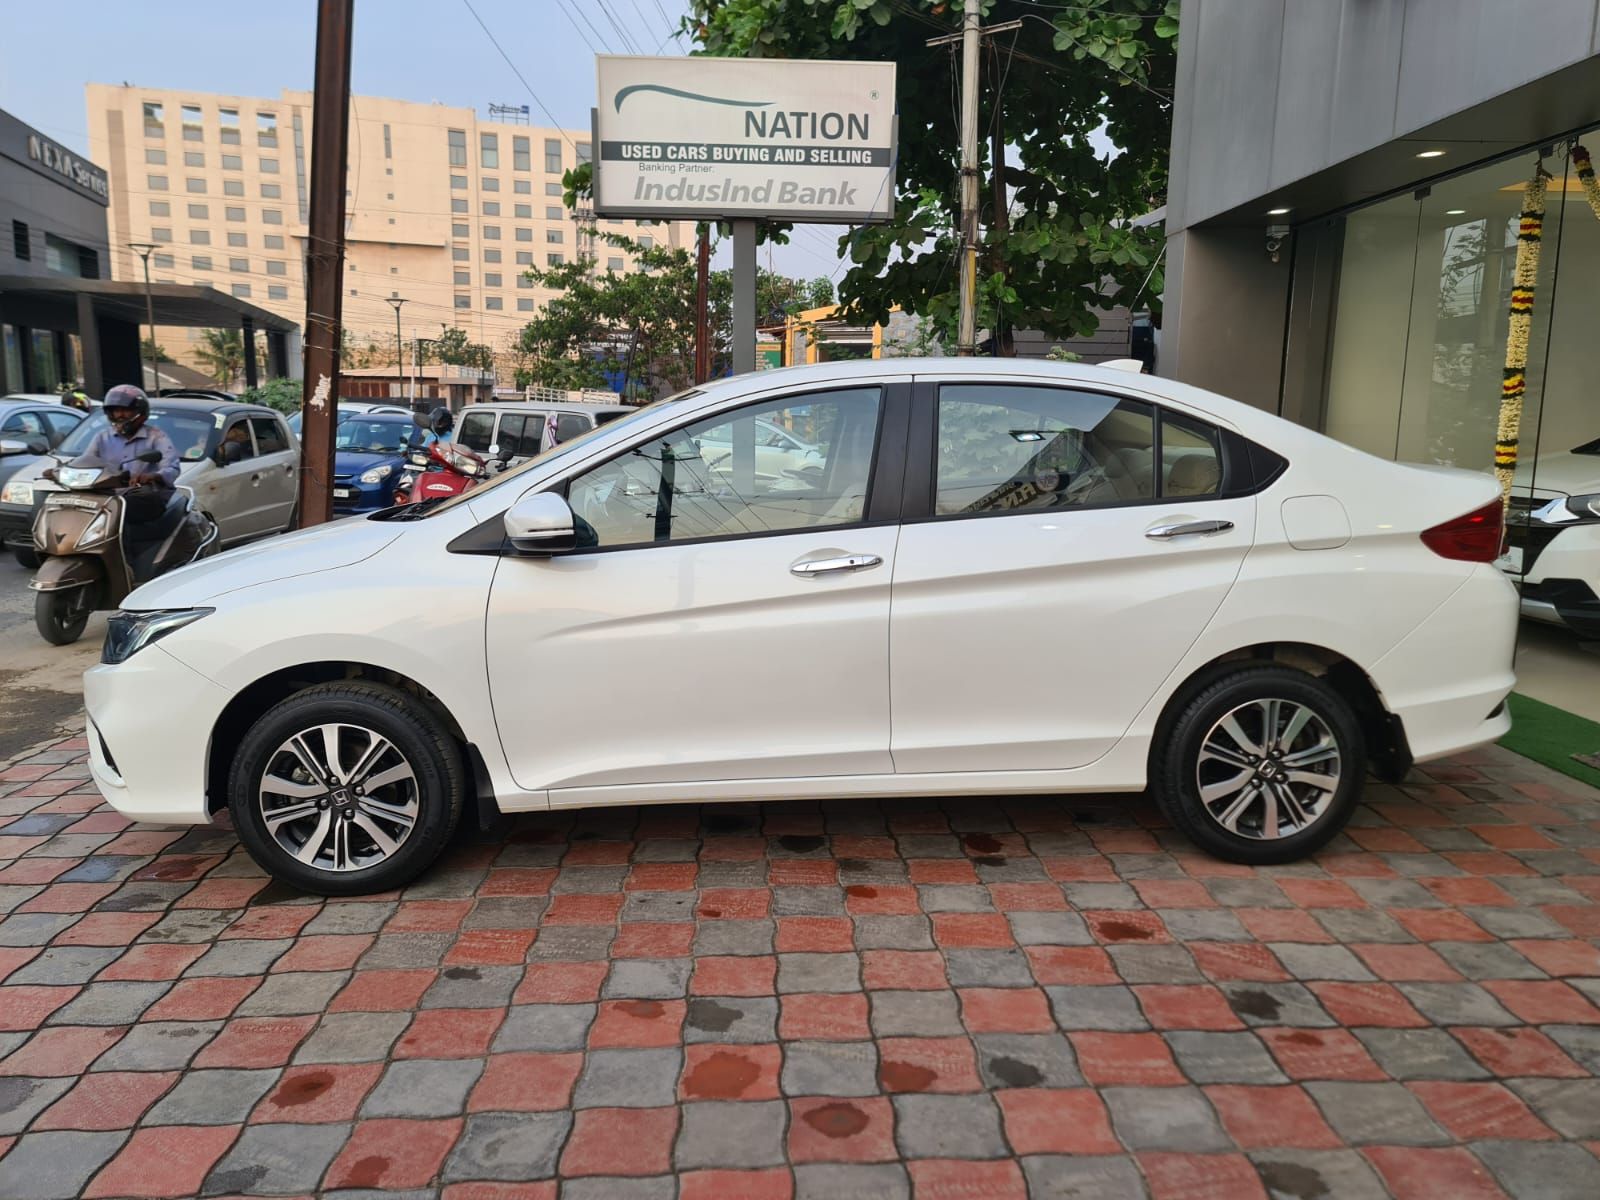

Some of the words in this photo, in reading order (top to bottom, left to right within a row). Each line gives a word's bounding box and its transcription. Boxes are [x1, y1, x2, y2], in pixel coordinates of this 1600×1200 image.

[744, 110, 869, 140] NATION
[621, 144, 662, 159] USED
[666, 145, 708, 160] CARS
[712, 146, 769, 162] BUYING
[774, 148, 805, 162] AND
[810, 149, 872, 164] SELLING
[638, 162, 676, 174] Banking
[633, 175, 774, 204] IndusInd
[777, 180, 858, 206] Bank
